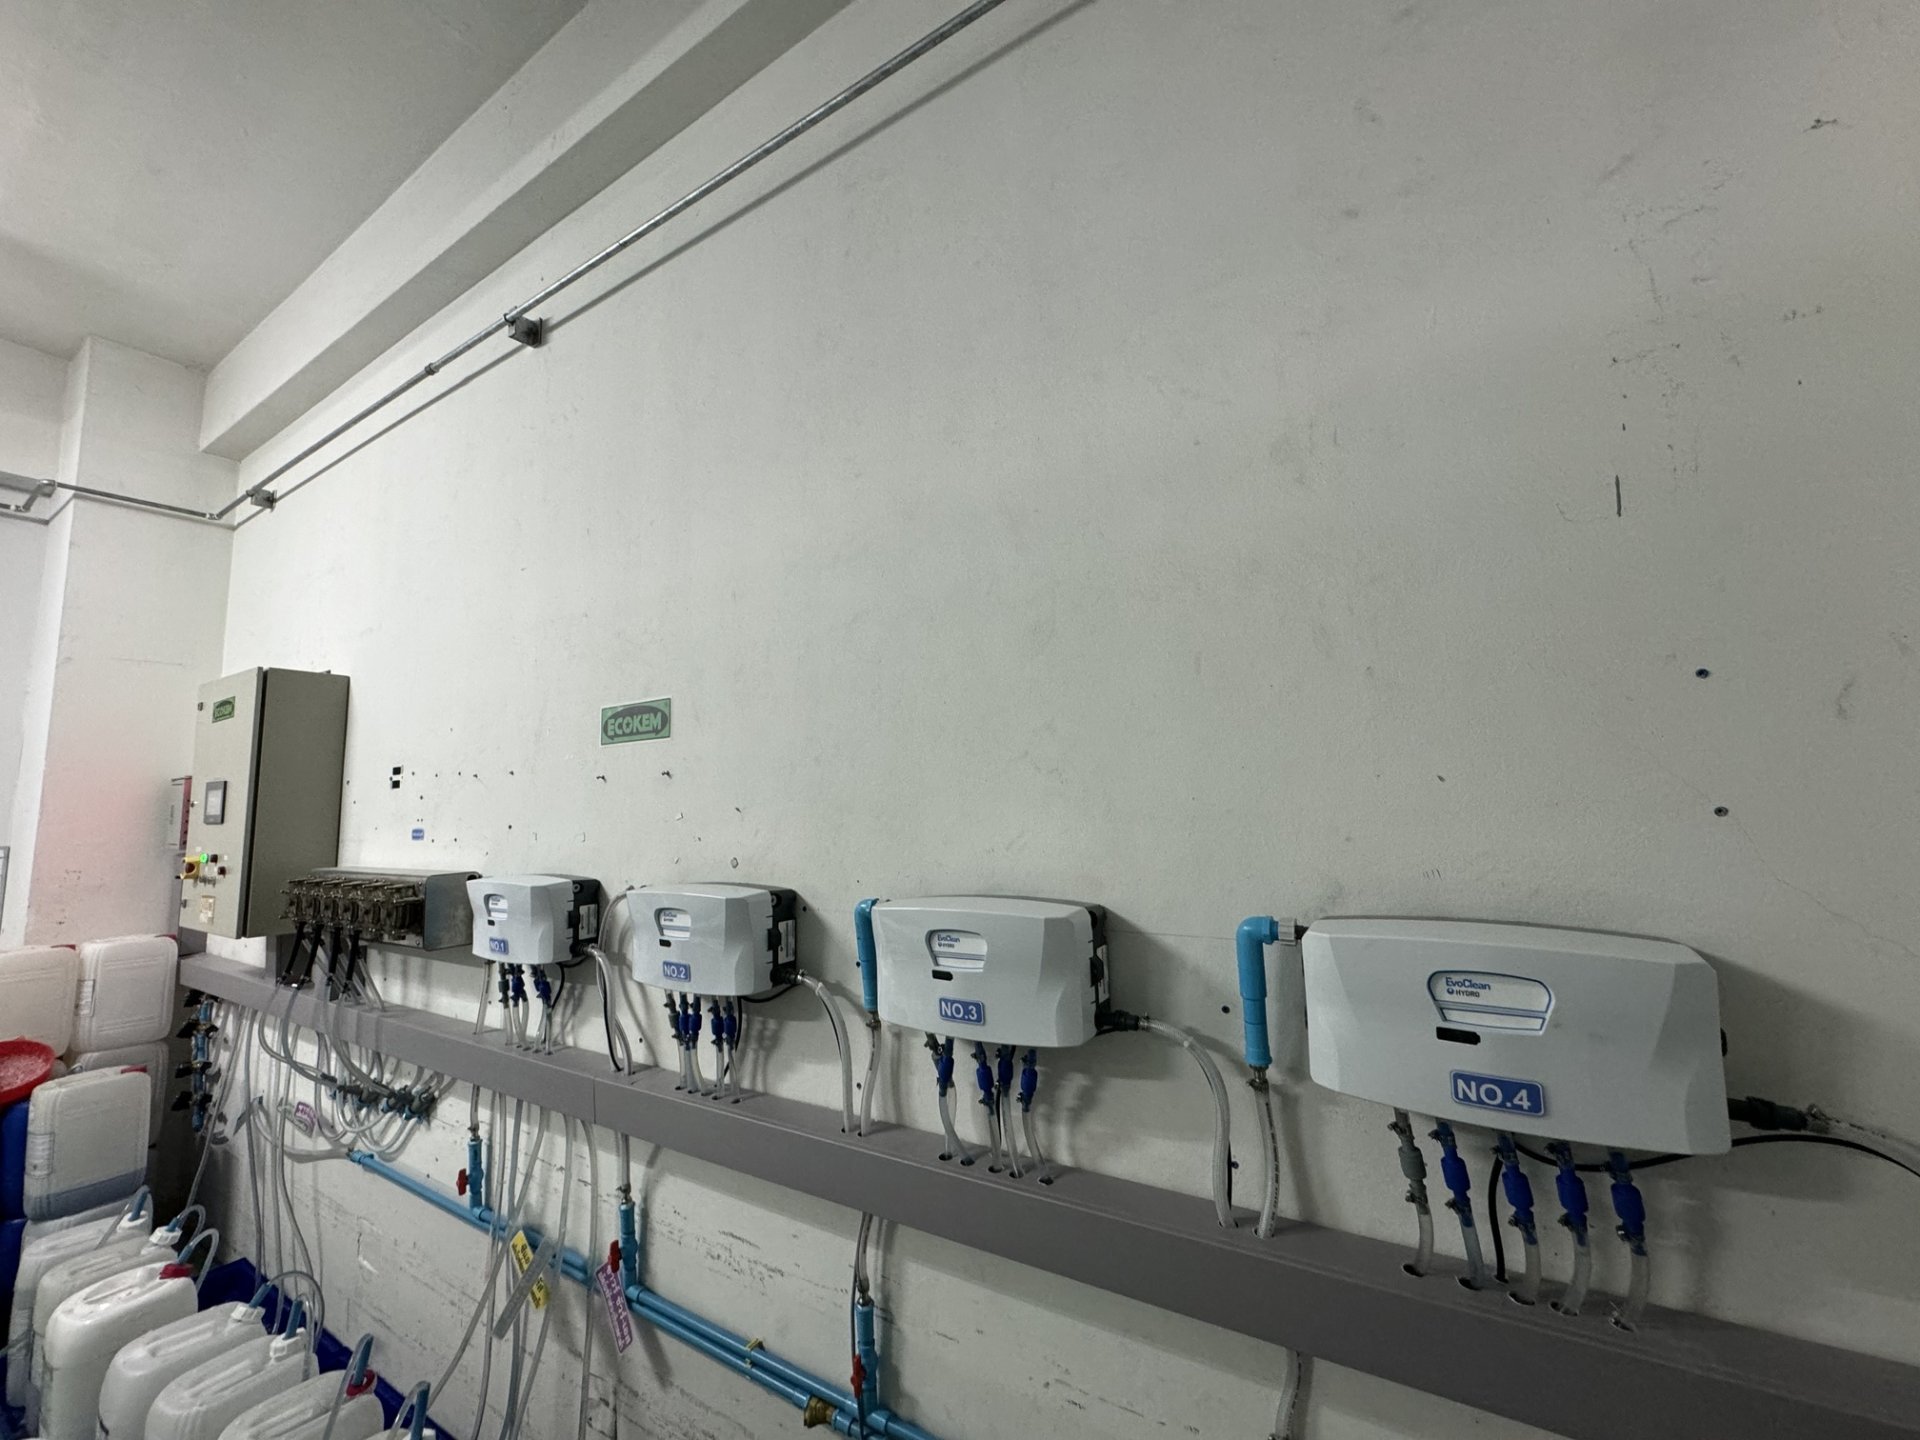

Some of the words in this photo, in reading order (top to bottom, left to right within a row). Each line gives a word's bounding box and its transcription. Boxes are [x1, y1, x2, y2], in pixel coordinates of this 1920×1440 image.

[607, 711, 662, 736] ECOKEM
[664, 964, 686, 979] NO.2
[1445, 976, 1492, 991] EvoClean
[1456, 989, 1480, 998] HYDRO
[941, 1000, 978, 1020] NO.3
[1456, 1078, 1532, 1111] NO.4
